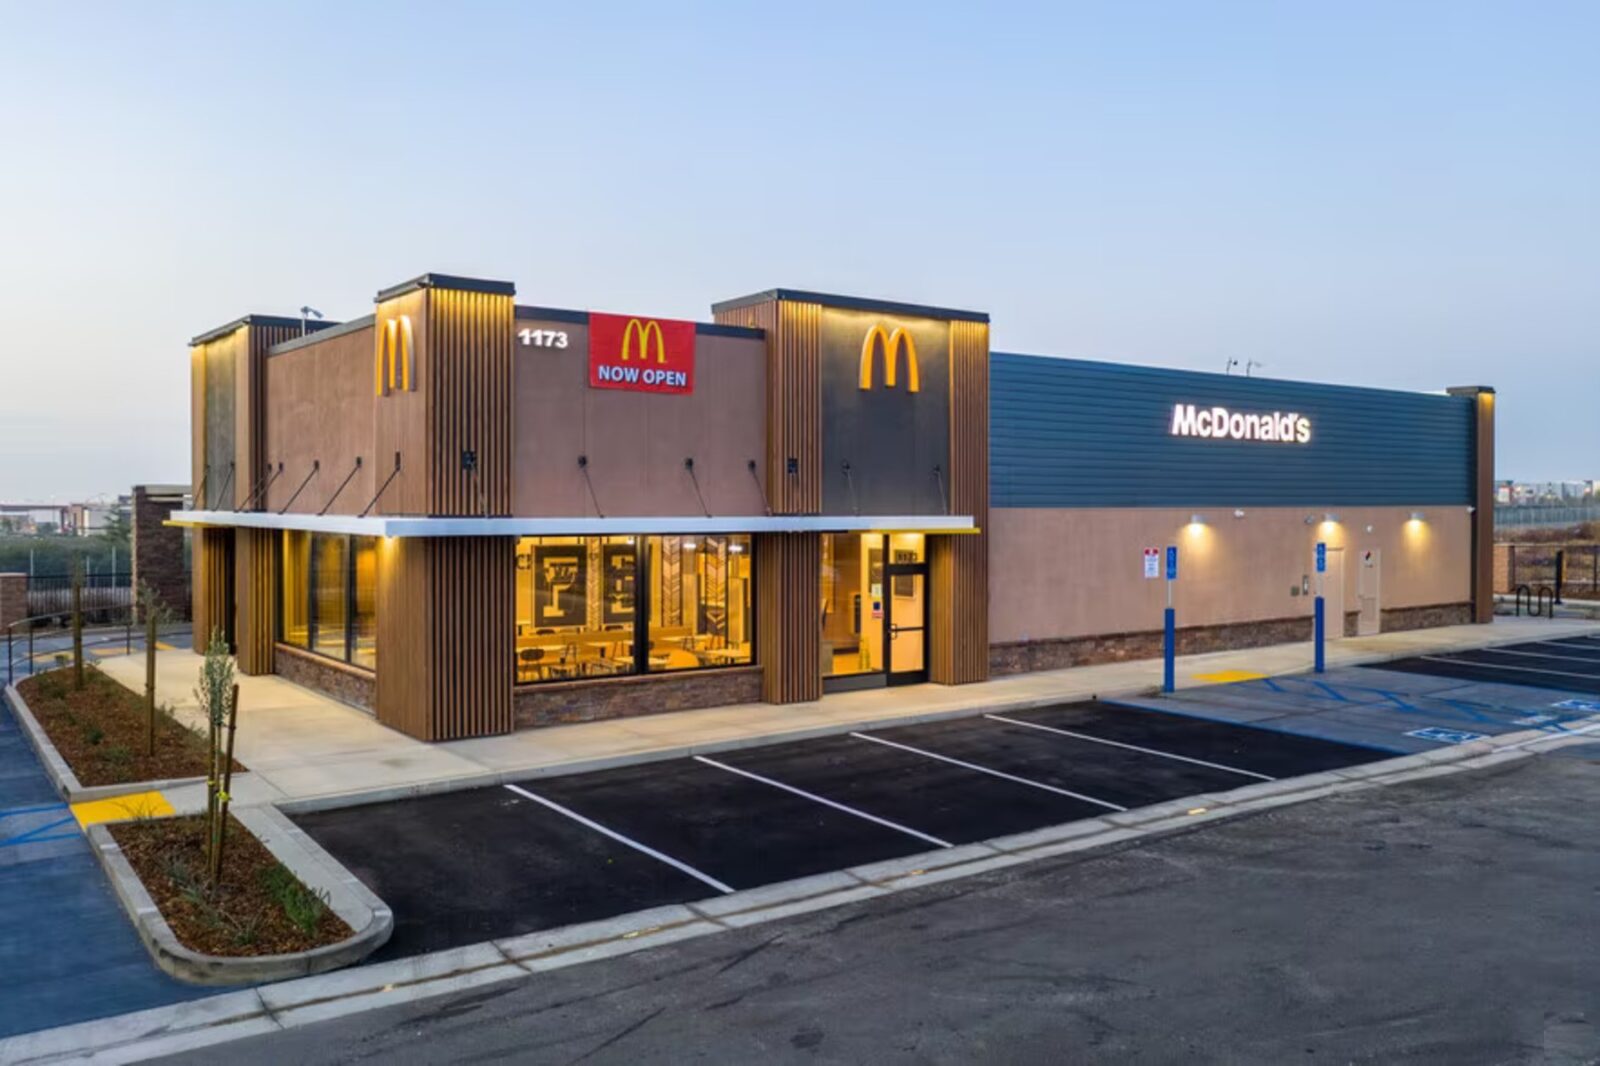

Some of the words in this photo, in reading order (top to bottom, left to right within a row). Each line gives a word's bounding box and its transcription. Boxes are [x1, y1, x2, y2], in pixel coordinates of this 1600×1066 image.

[518, 328, 568, 348] 1173
[598, 366, 639, 382] NOW
[643, 369, 686, 386] OPEN
[1172, 404, 1311, 443] McDonald's
